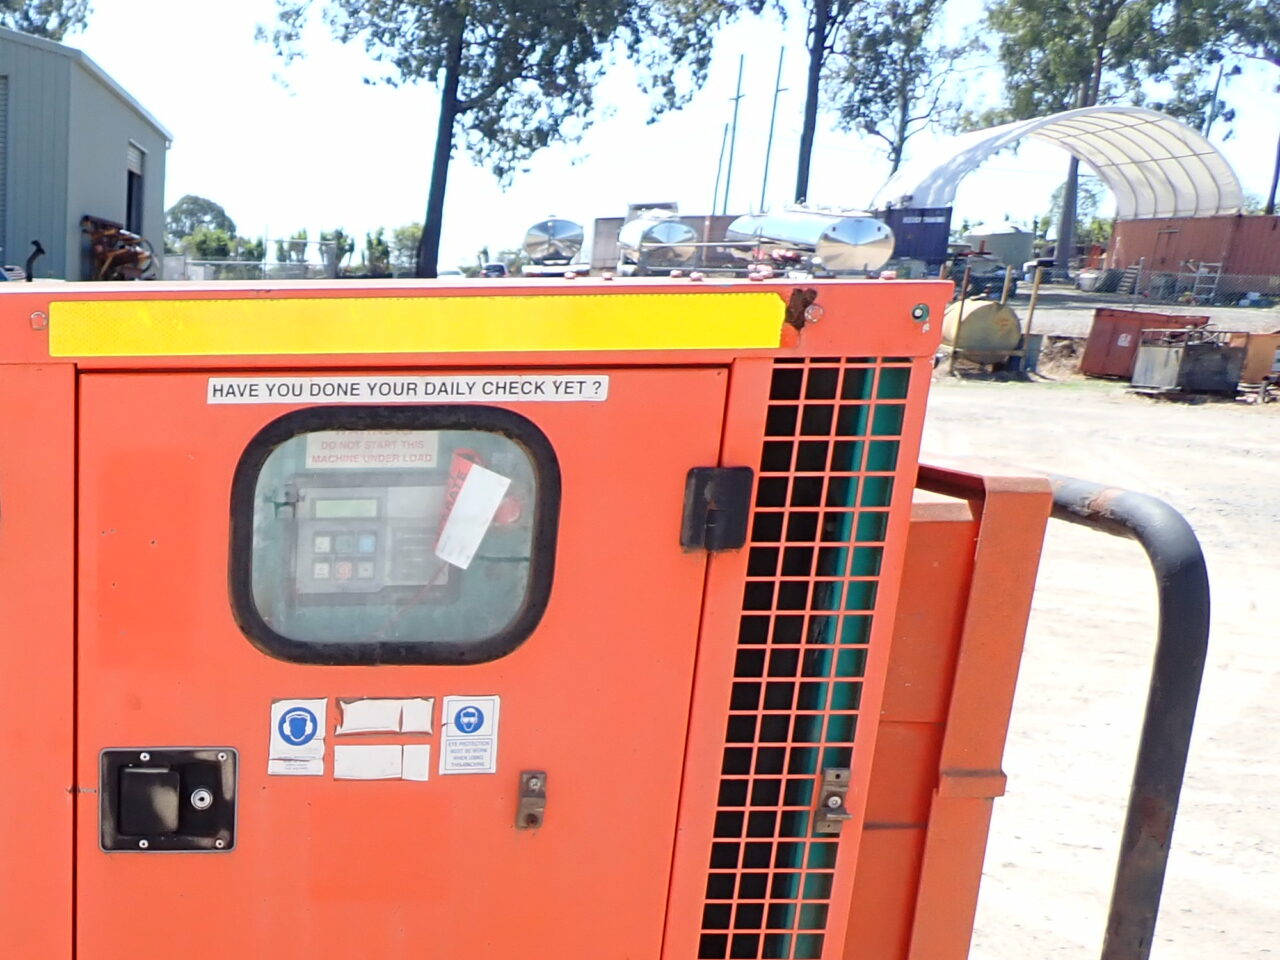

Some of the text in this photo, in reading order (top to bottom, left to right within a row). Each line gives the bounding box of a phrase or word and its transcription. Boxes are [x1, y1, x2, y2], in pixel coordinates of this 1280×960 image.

[212, 383, 260, 398] HAVE
[266, 383, 304, 397] YOU
[310, 382, 361, 397] DONE
[367, 382, 418, 397] YOUR
[424, 381, 477, 396] DAILY
[482, 380, 546, 396] CHECK
[552, 380, 587, 395] YET
[321, 440, 425, 450] DO NOT START THIS
[311, 453, 433, 463] MACHINE UNDER LOAD
